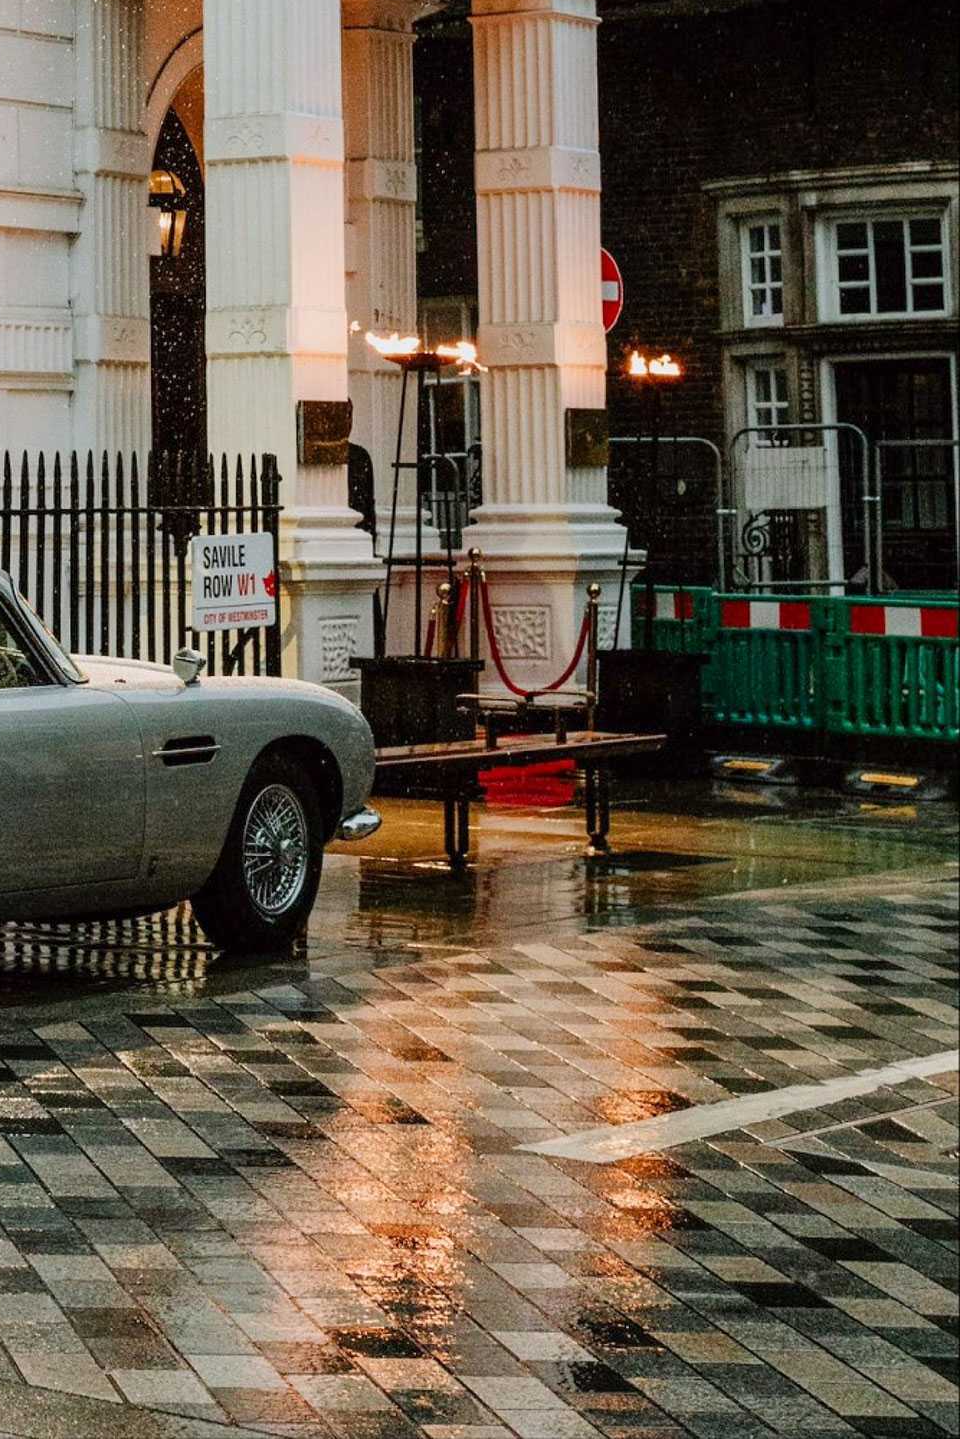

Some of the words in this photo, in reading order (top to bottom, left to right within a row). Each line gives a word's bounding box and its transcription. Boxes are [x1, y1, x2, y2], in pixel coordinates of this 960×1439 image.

[203, 544, 246, 569] SAVILE
[204, 574, 233, 599] ROW
[237, 573, 256, 596] W1
[204, 613, 217, 625] CITY
[218, 612, 226, 623] OF
[228, 609, 268, 622] WESTMINSTER
